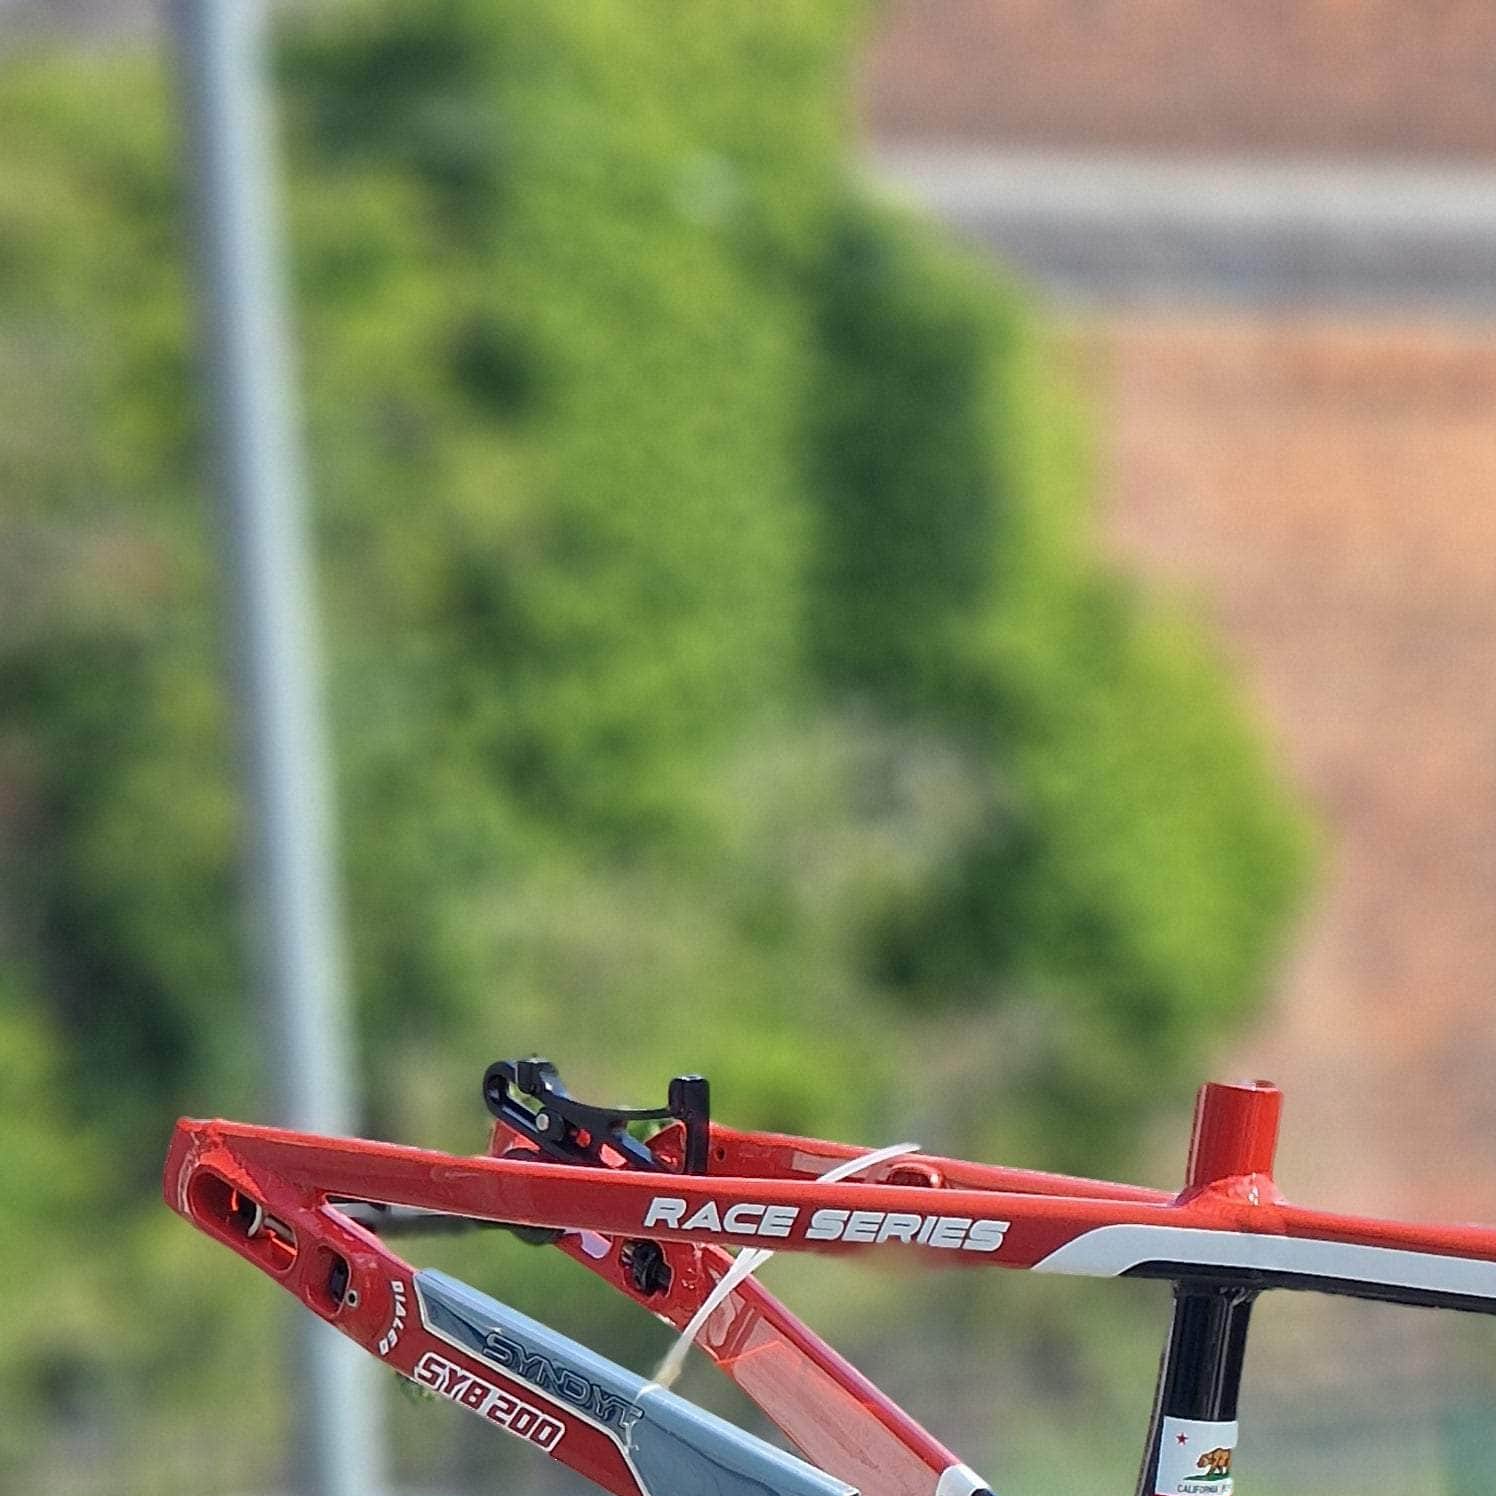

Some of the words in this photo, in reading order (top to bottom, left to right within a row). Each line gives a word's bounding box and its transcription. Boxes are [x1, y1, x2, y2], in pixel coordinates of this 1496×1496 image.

[645, 1197, 800, 1238] RACE
[805, 1208, 1010, 1252] SERIES
[379, 1281, 407, 1355] DIALED
[414, 1352, 490, 1411] SYB
[486, 1393, 565, 1452] 200
[483, 1331, 644, 1429] SYNDYT
